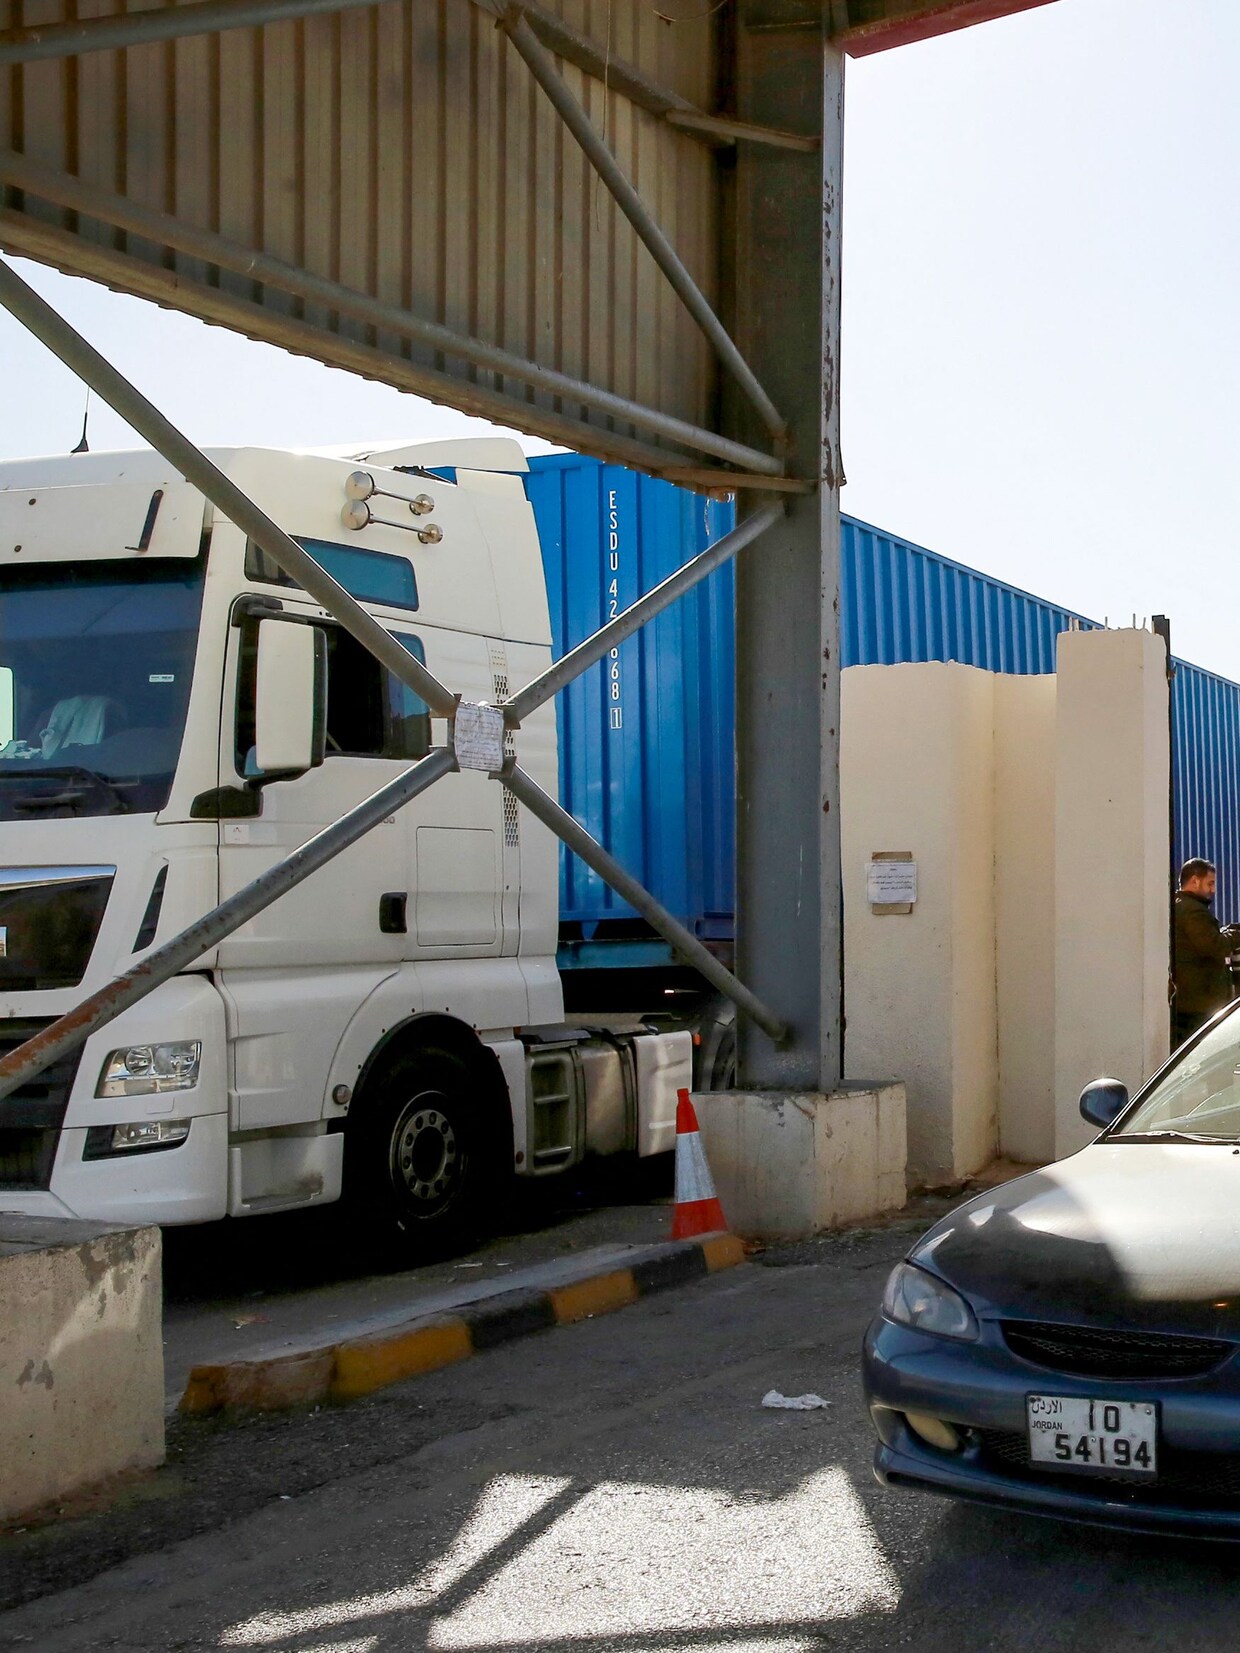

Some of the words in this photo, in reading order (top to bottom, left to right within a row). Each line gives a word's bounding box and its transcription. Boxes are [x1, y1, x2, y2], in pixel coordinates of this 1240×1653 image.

[608, 490, 618, 570] ESDU
[1031, 1420, 1063, 1430] JORDAN
[1088, 1402, 1120, 1433] 10
[1055, 1433, 1150, 1467] 54194
